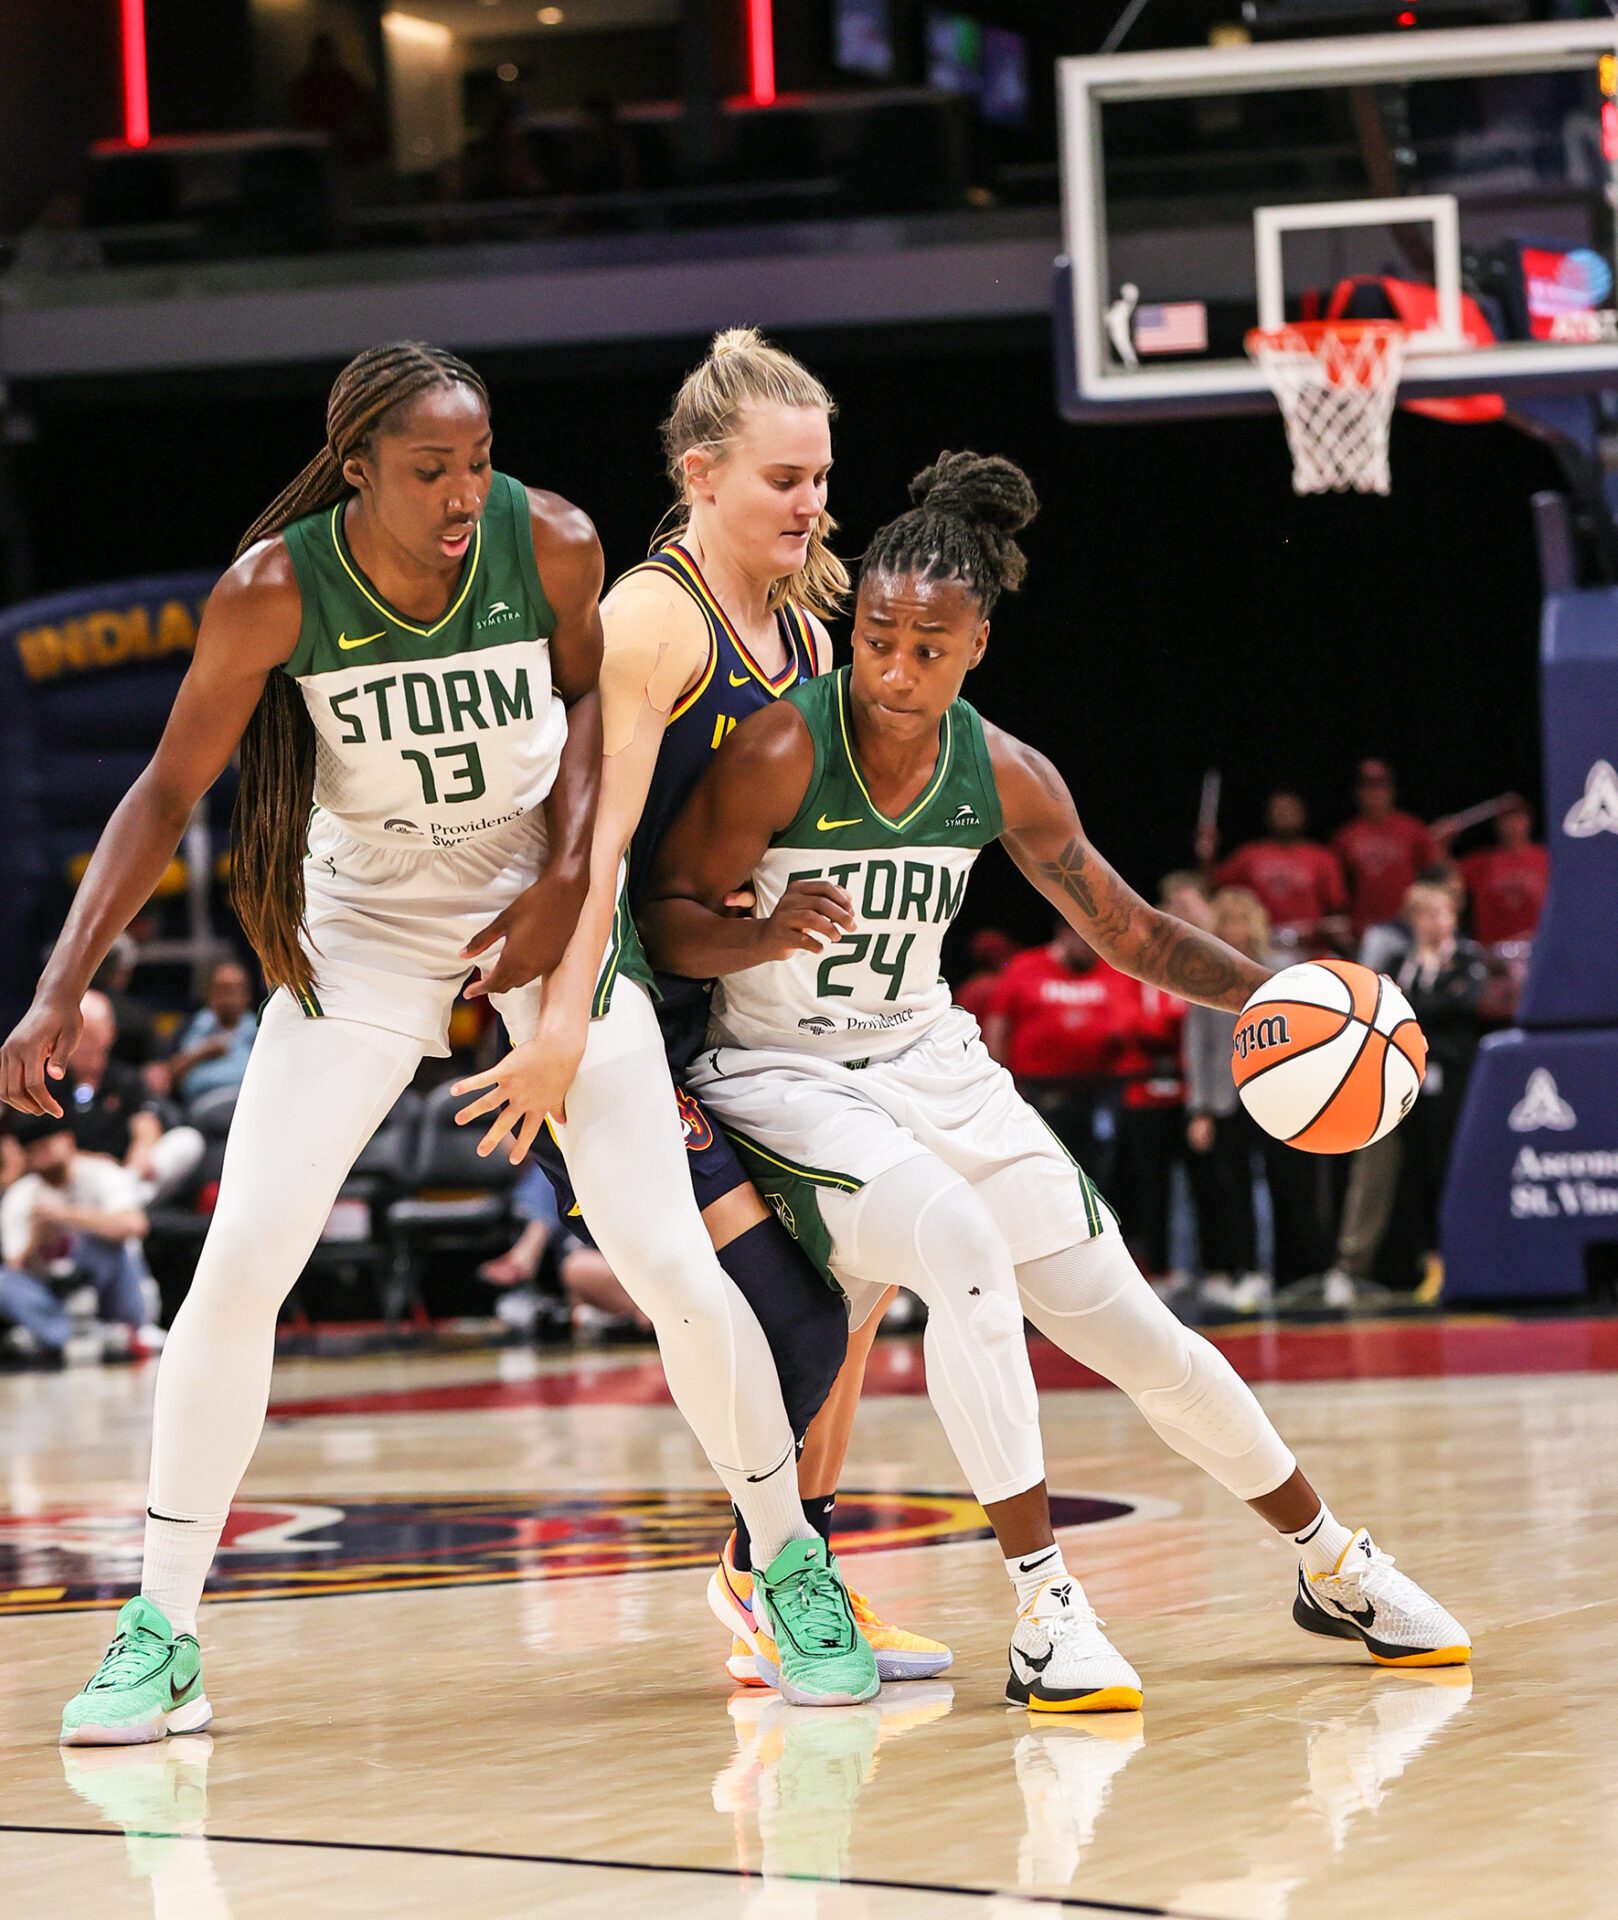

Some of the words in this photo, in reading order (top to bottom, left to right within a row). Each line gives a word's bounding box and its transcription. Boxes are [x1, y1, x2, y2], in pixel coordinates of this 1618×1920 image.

[17, 600, 206, 682] INDIA
[476, 611, 521, 630] SYMETRA
[329, 668, 534, 744] STORM
[400, 741, 486, 804] 13
[430, 806, 524, 835] Providence
[945, 817, 980, 827] SYMETRA
[816, 933, 916, 1001] 24
[847, 1007, 913, 1030] Providence
